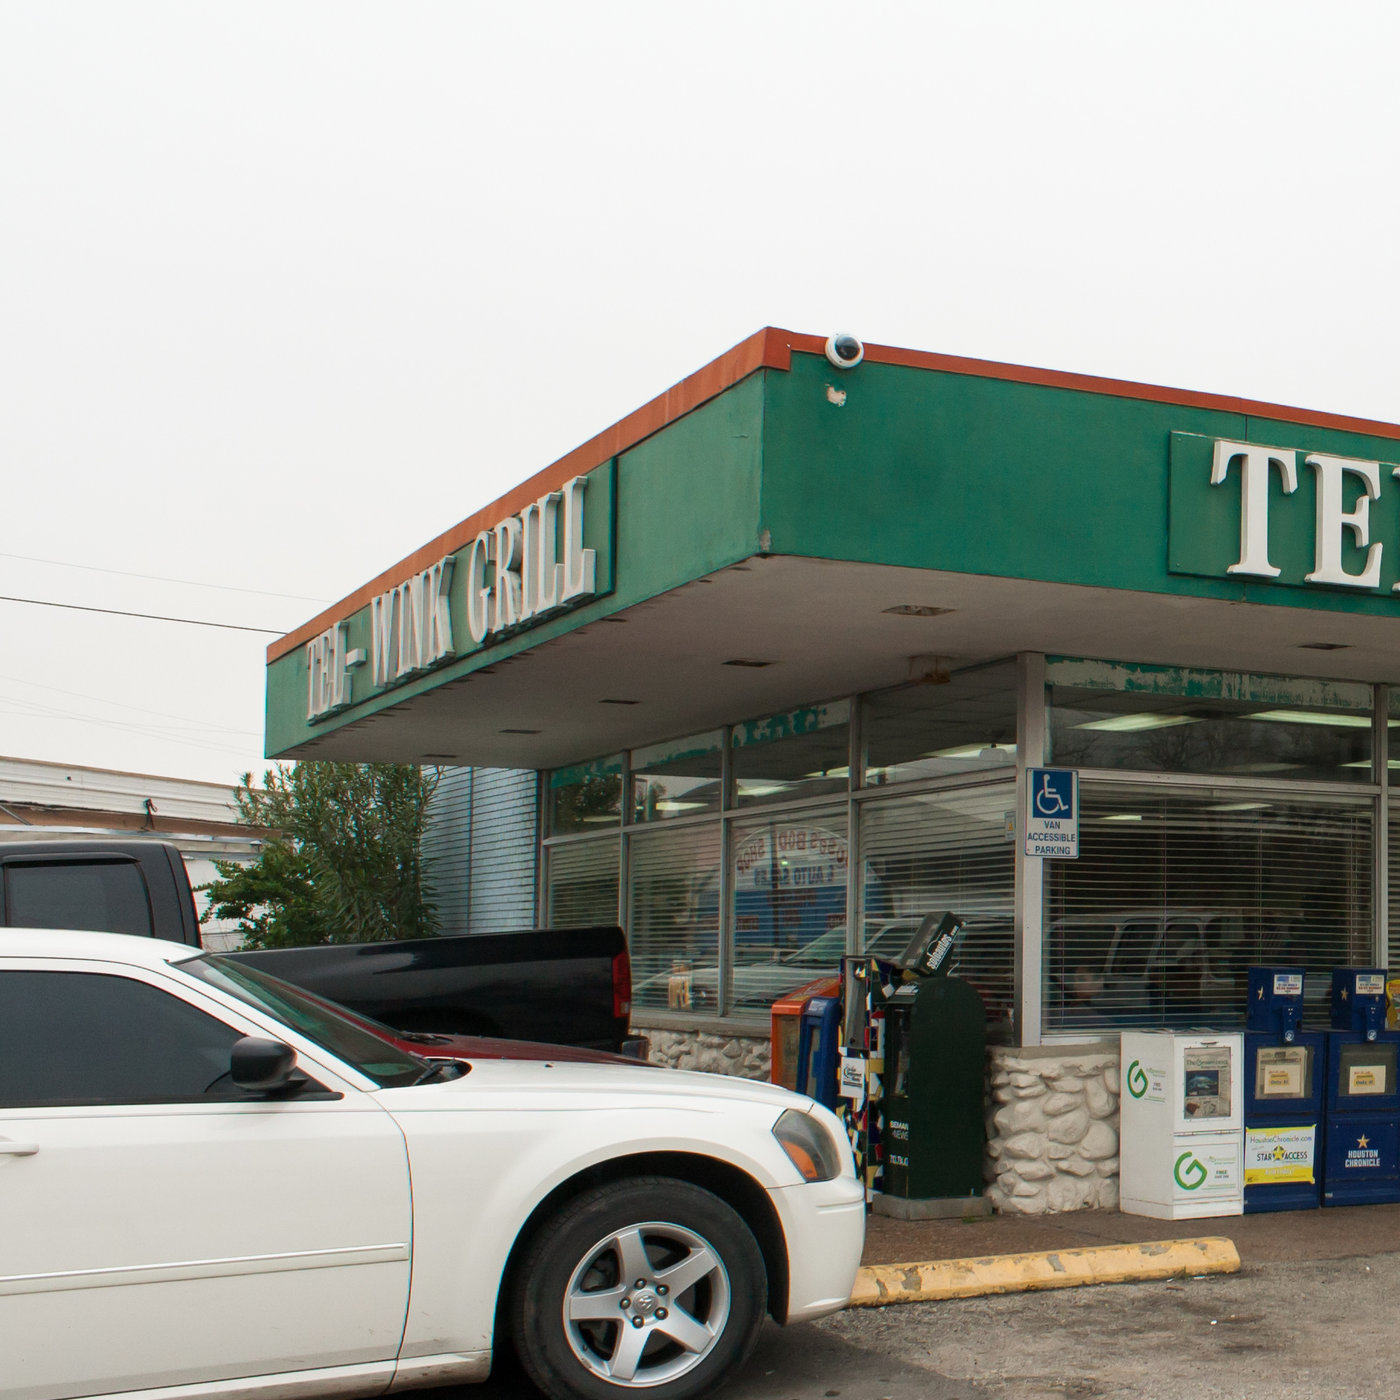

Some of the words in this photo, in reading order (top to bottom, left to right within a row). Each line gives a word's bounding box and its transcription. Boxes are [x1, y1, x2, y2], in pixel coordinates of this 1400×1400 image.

[467, 475, 597, 644] GRILL
[1043, 820, 1061, 830] VAN
[1027, 832, 1076, 843] ACCESSIBLE
[1034, 845, 1071, 855] PARKING
[1256, 1152, 1272, 1162] STAR
[1284, 1150, 1308, 1161] ACCESS
[1347, 1149, 1379, 1159] HOUSTON
[1344, 1158, 1381, 1168] CHRONICLE
